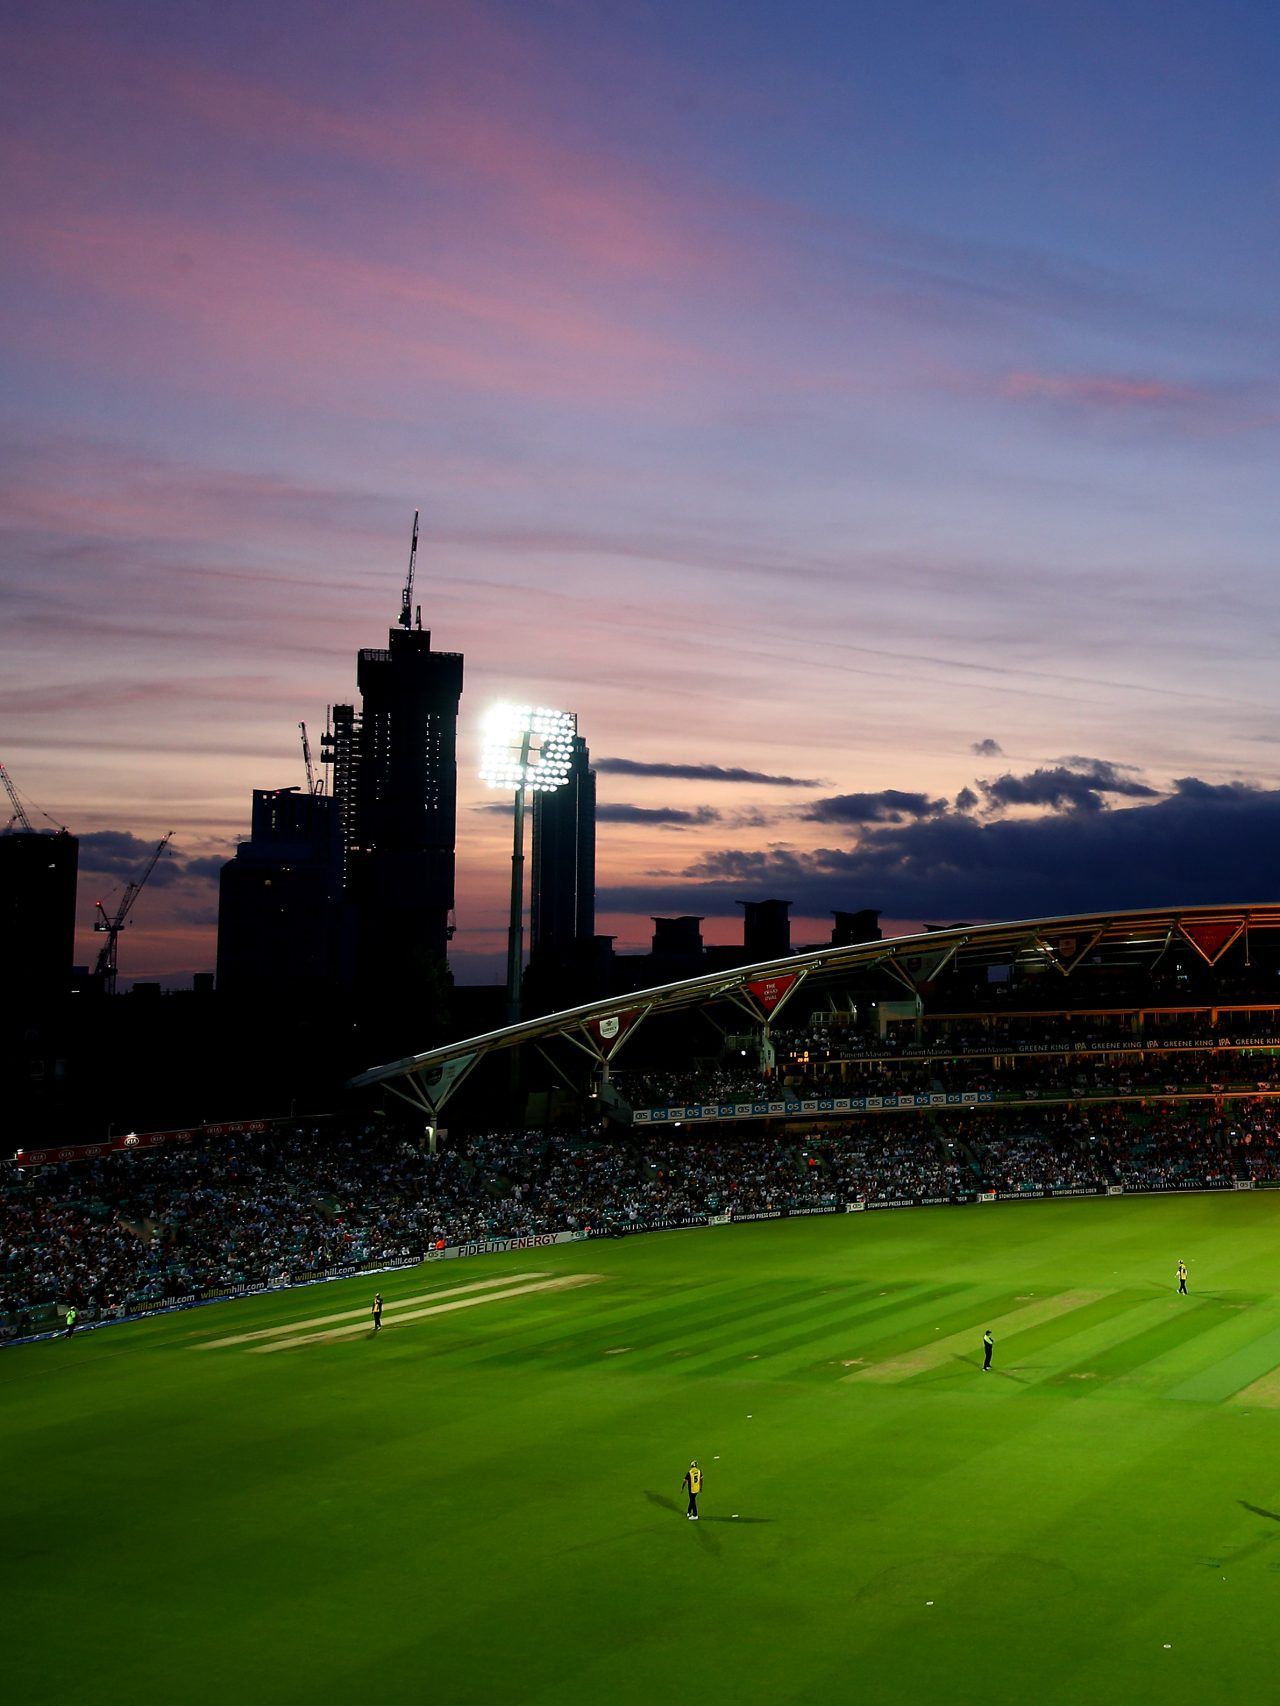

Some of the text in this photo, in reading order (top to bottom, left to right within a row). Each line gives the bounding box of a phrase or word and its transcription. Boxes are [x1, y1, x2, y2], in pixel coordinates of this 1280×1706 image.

[1122, 1041, 1142, 1049] KING
[1235, 1038, 1264, 1046] GREENE
[361, 1256, 421, 1271] williamhill.com
[295, 1265, 356, 1282] williamhill.com
[200, 1282, 265, 1300] williamhill.com
[130, 1294, 195, 1313] williamhill.com
